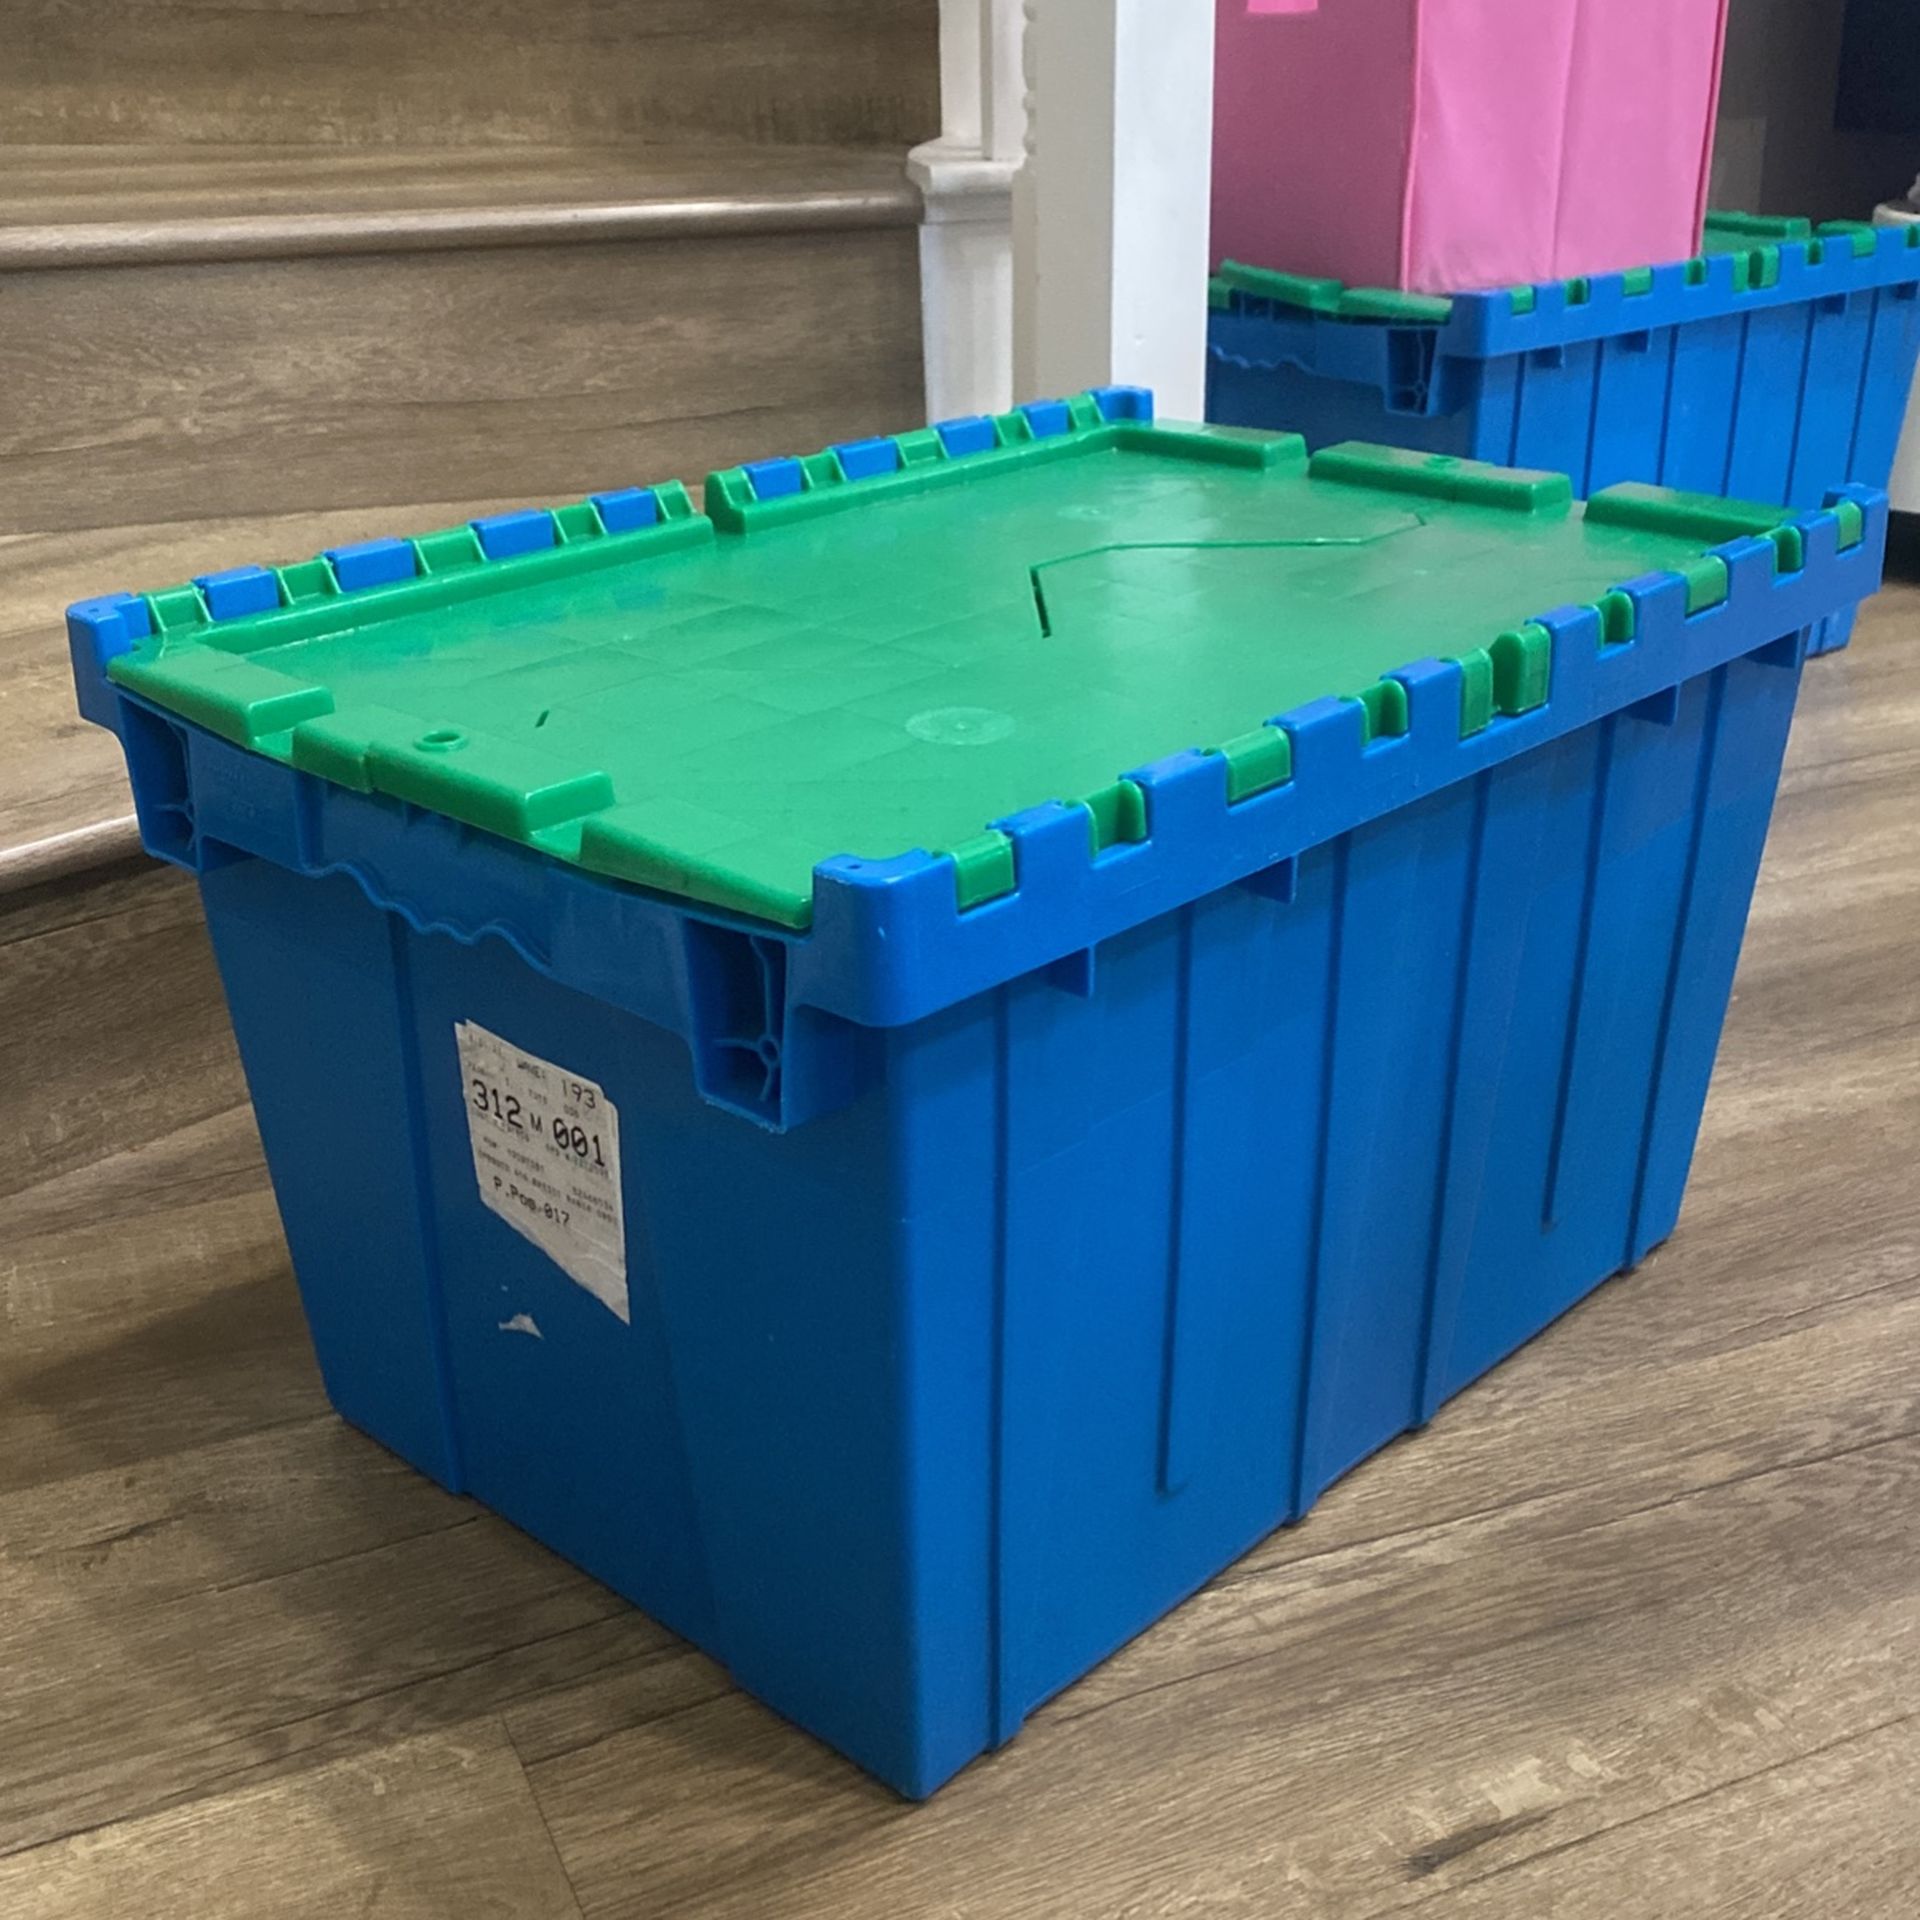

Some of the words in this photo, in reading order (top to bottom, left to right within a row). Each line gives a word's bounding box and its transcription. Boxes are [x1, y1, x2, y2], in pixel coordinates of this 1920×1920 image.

[472, 1079, 523, 1129] 312
[552, 1117, 605, 1168] 001
[561, 1079, 596, 1110] 193
